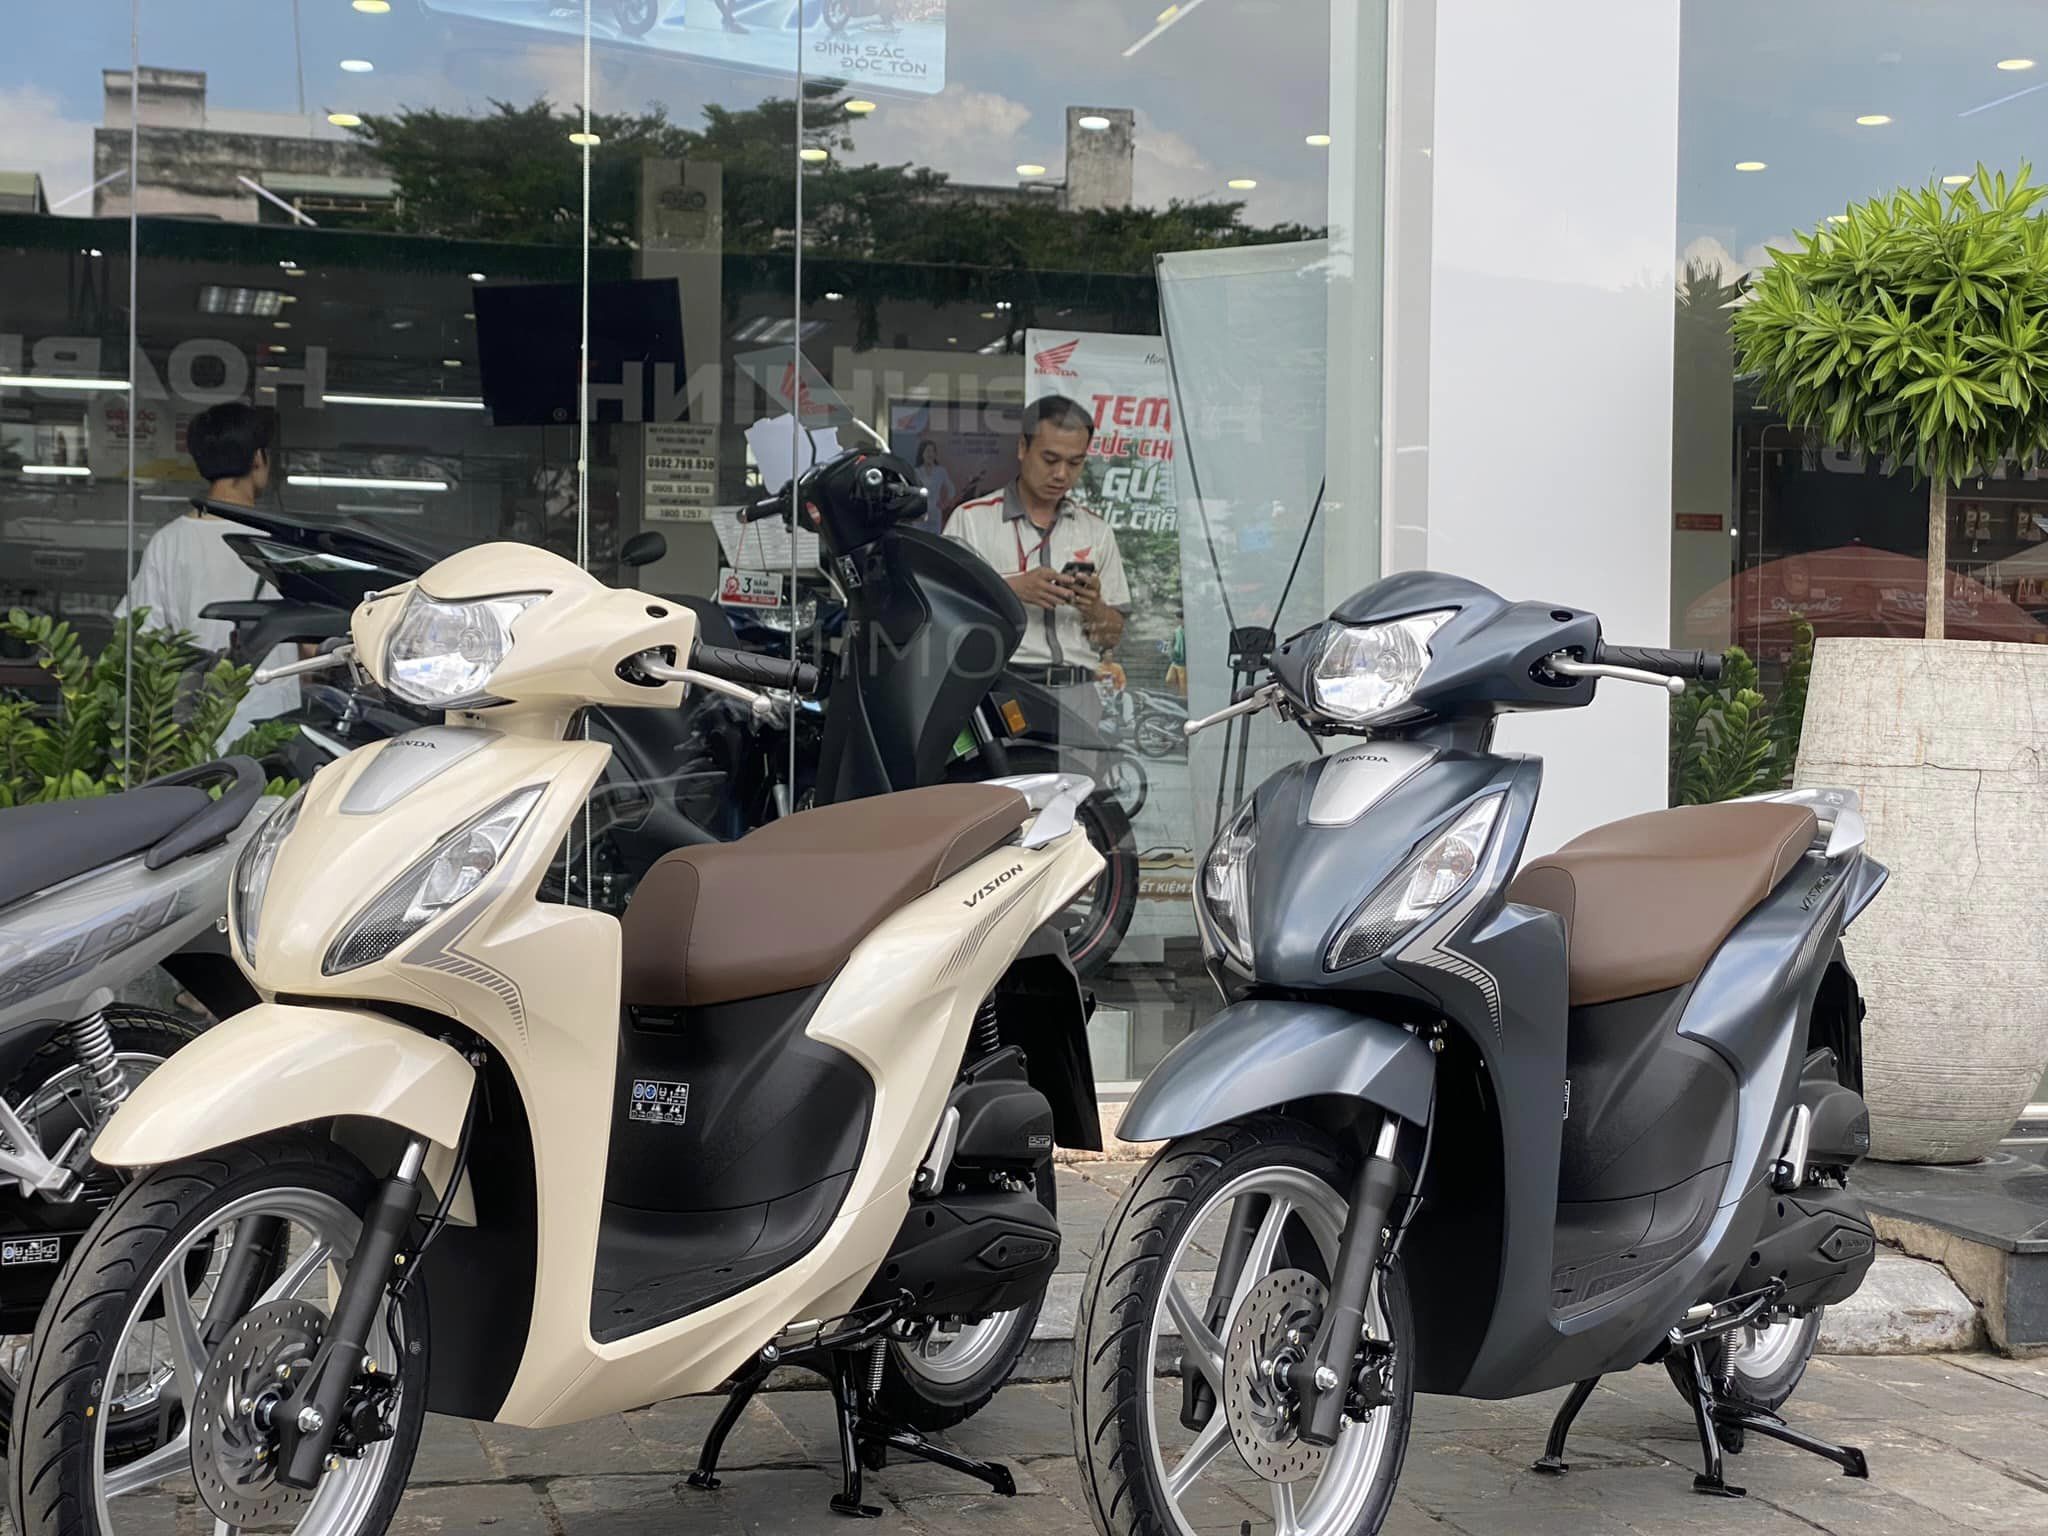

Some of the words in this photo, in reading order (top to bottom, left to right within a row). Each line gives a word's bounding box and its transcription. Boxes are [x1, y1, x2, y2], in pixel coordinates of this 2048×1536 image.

[1091, 394, 1172, 434] TEM
[742, 576, 753, 594] 3
[1336, 755, 1388, 765] HONDA
[962, 863, 1024, 908] VISION
